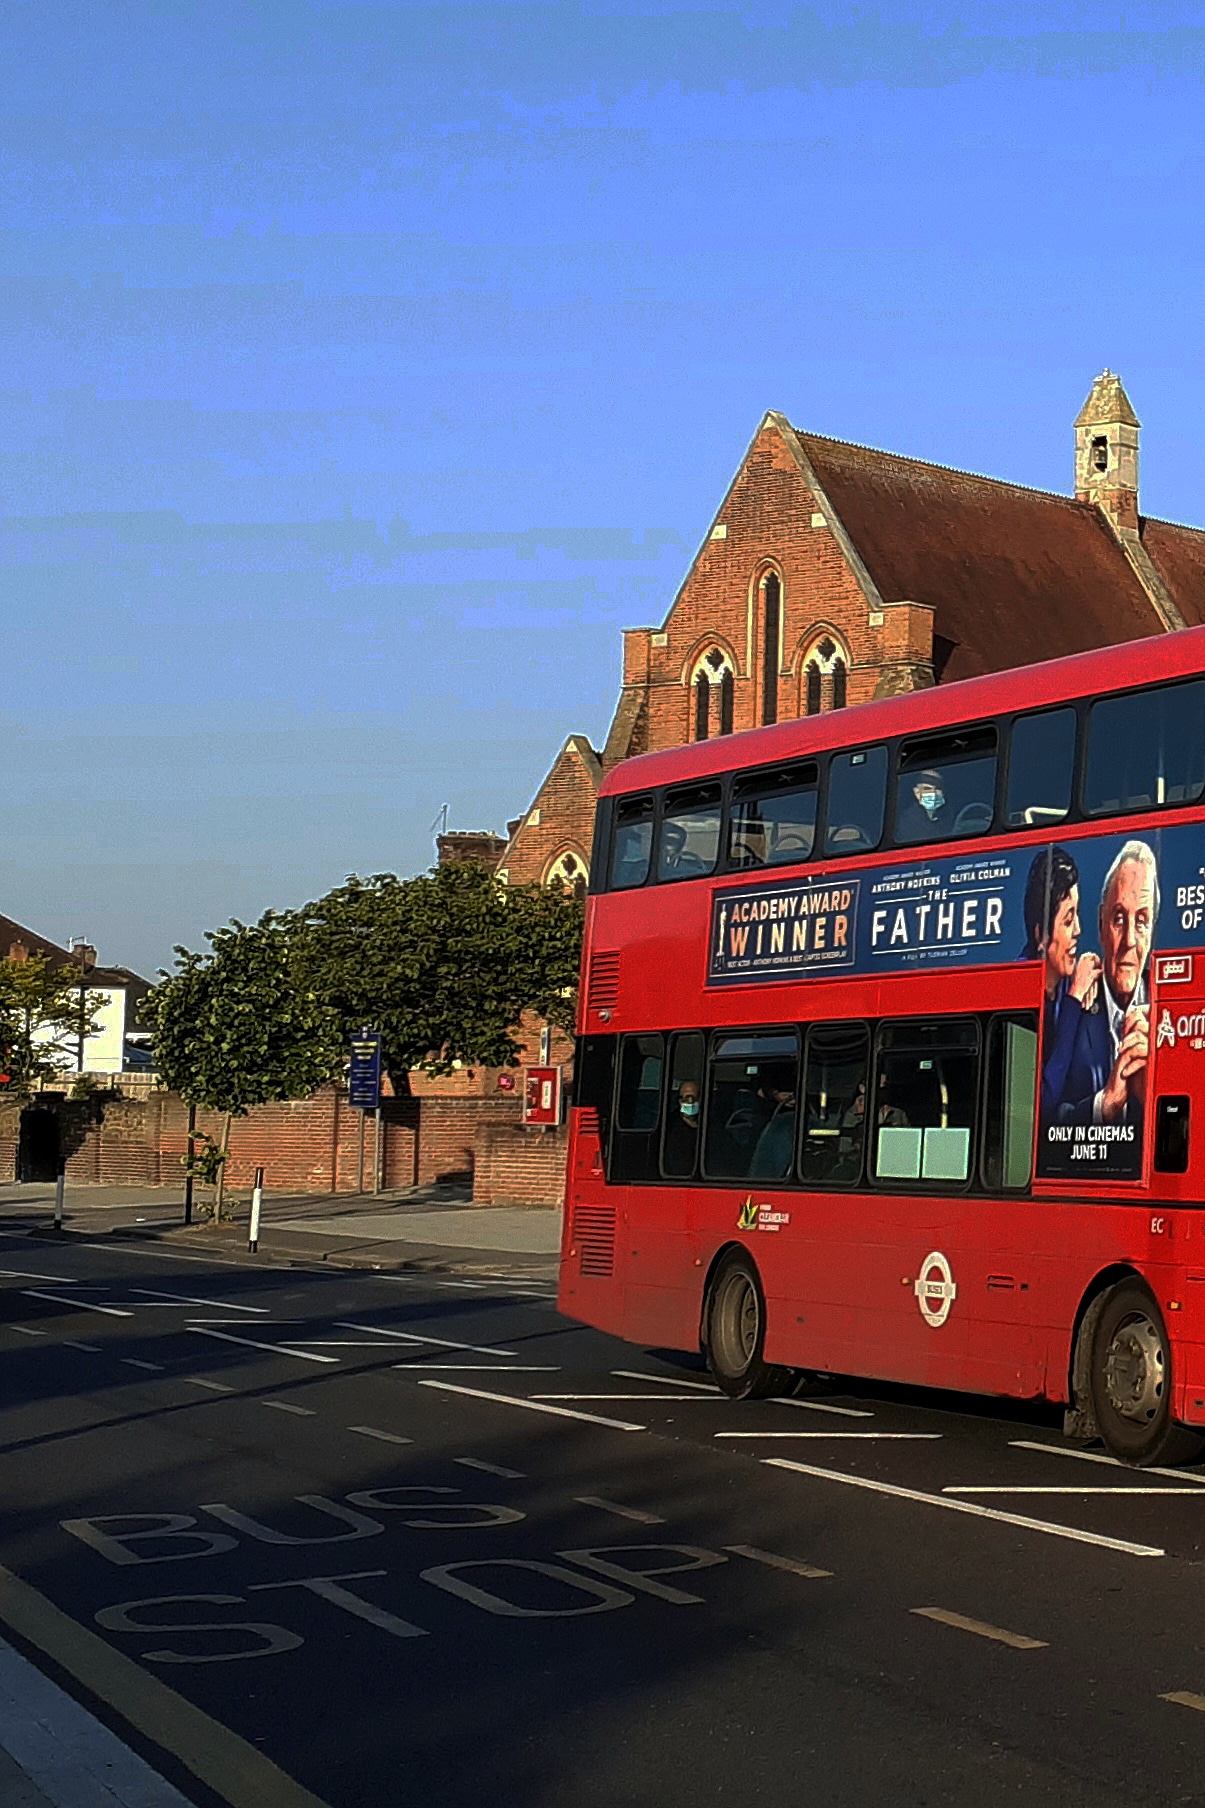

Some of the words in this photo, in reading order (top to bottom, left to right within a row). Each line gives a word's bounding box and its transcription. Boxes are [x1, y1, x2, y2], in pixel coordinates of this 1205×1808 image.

[871, 880, 905, 893] ANTHONY
[907, 875, 941, 889] HOPKINS
[950, 872, 975, 883] OLIVIA
[978, 867, 1011, 880] COLMAN
[928, 889, 948, 901] THE
[731, 896, 799, 923] ACADEMY
[1181, 908, 1203, 930] OF
[871, 897, 1003, 946] FATHER
[730, 915, 848, 957] WINNER
[1048, 1126, 1073, 1141] ONLY
[1075, 1126, 1086, 1141] IN
[1087, 1126, 1134, 1142] CINEMAS
[1070, 1144, 1096, 1160] JUNE
[1098, 1144, 1107, 1160] 11
[1151, 1217, 1164, 1234] EC
[58, 1486, 527, 1566] BUS
[95, 1543, 730, 1664] STOP
